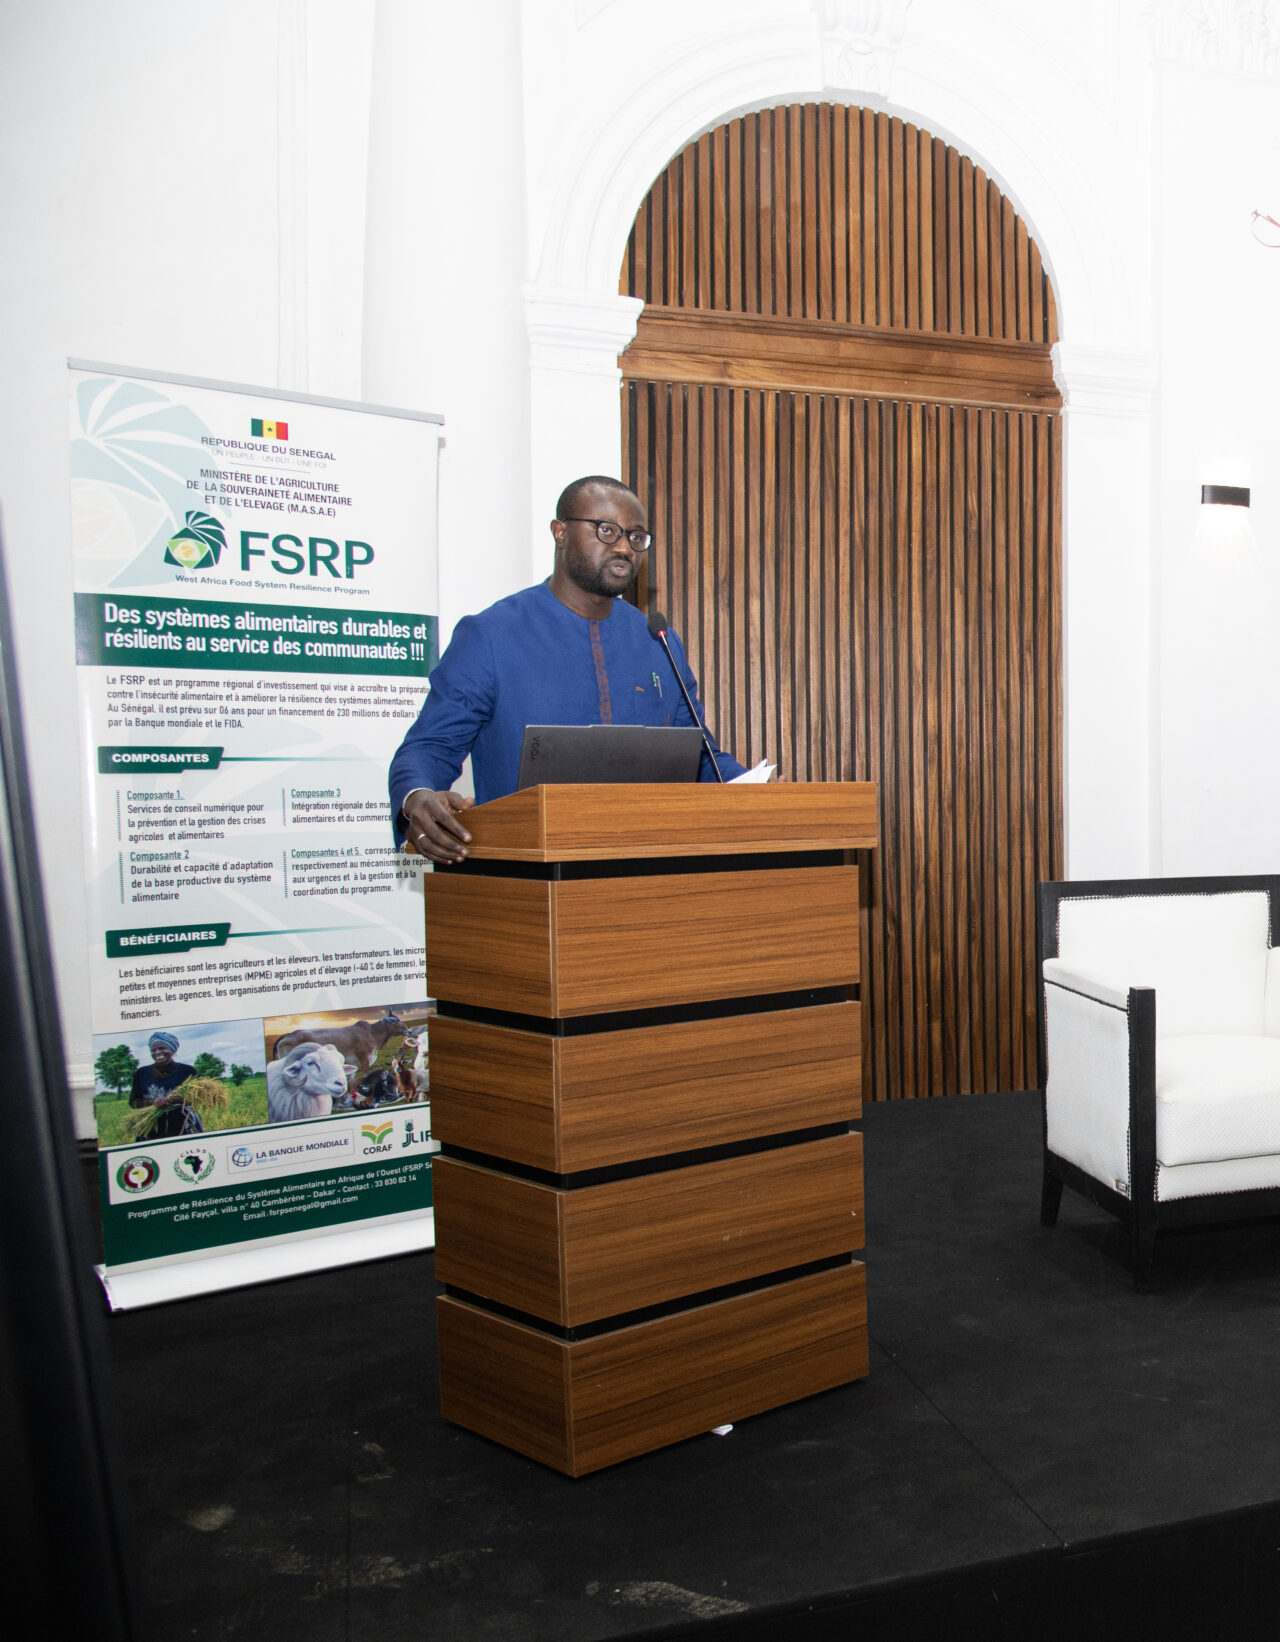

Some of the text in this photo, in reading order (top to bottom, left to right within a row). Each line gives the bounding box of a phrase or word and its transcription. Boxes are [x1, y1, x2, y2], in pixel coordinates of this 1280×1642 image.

[201, 436, 336, 460] REPUBLIQUE DU SENEGAL
[199, 468, 339, 492] MINISTÈRE DE L'AGRICULTURE
[186, 480, 351, 506] DE LA SOUVERAINETÉ ALIMENTAIRE
[204, 494, 335, 518] ET DE L'ELEVAGE (M.A.S.A.E)
[240, 530, 374, 579] FSRP
[175, 574, 369, 595] West Africa Food System Resilience Program
[104, 602, 427, 640] Des systèmes alimentaires durables et
[104, 628, 424, 661] résilients au service des communautés !!!
[111, 753, 209, 762] COMPOSANTES
[126, 790, 184, 801] Composante 1.
[127, 803, 264, 813] Services de conseil numérique pour
[119, 930, 216, 946] BÉNÉFICIAIRES
[255, 1138, 348, 1159] LA BANQUE MONDIALE
[363, 1143, 392, 1155] CORAF
[127, 1205, 177, 1219] Programme
[179, 1202, 190, 1210] de
[191, 1196, 233, 1208] Résilience
[235, 1193, 245, 1201] du
[246, 1188, 280, 1199] Système
[282, 1180, 325, 1193] Alimentaire
[337, 1174, 364, 1187] Afrique
[365, 1171, 375, 1179] de
[375, 1167, 402, 1182] l'Ouest
[173, 1212, 189, 1221] Cité
[191, 1208, 219, 1219] Fayçal,
[220, 1205, 238, 1213] villa
[250, 1200, 260, 1208] 40
[312, 1189, 335, 1202] Dakar
[342, 1182, 369, 1193] Contact
[374, 1179, 383, 1187] 33
[384, 1177, 397, 1186] 830
[398, 1175, 407, 1183] 82
[269, 1195, 358, 1216] fsrpsenegal@gmail.com
